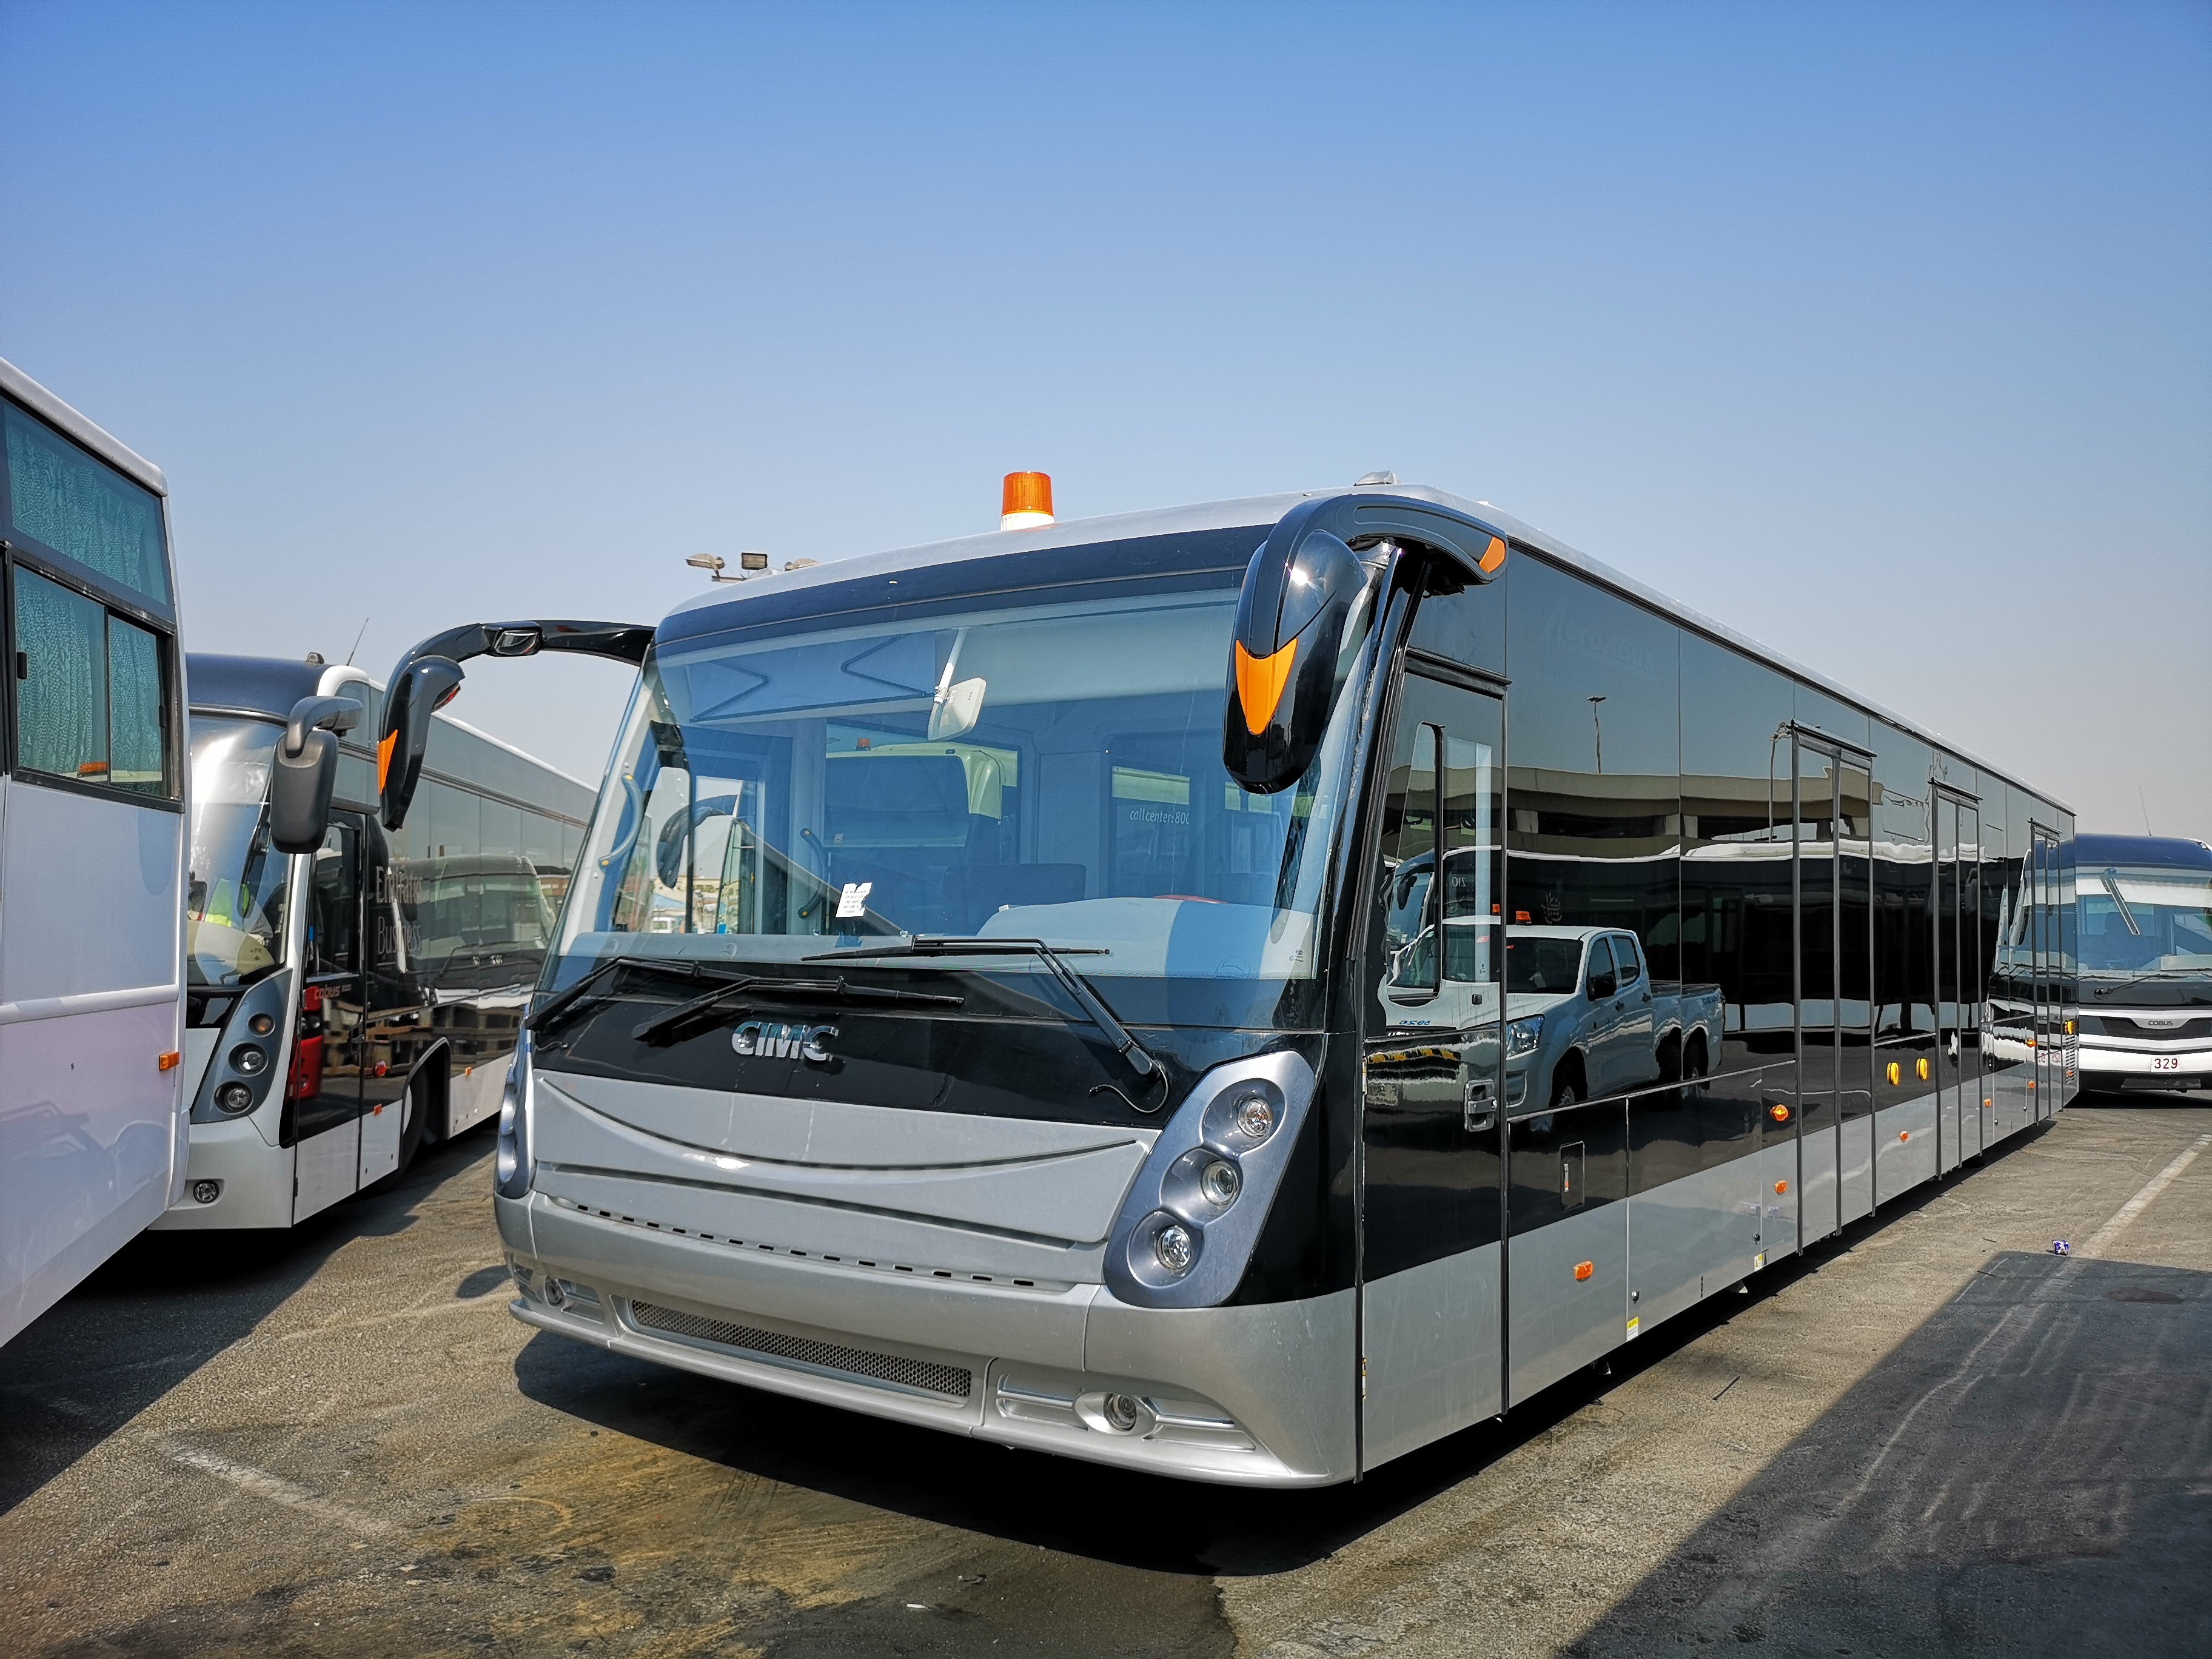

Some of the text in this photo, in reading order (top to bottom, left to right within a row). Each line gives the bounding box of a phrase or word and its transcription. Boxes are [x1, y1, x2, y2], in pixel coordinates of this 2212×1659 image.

[1130, 808, 1145, 821] call
[1145, 811, 1174, 823] center:
[376, 865, 423, 904] Emirates
[731, 1021, 839, 1062] CIMC
[2154, 1057, 2178, 1069] 329
